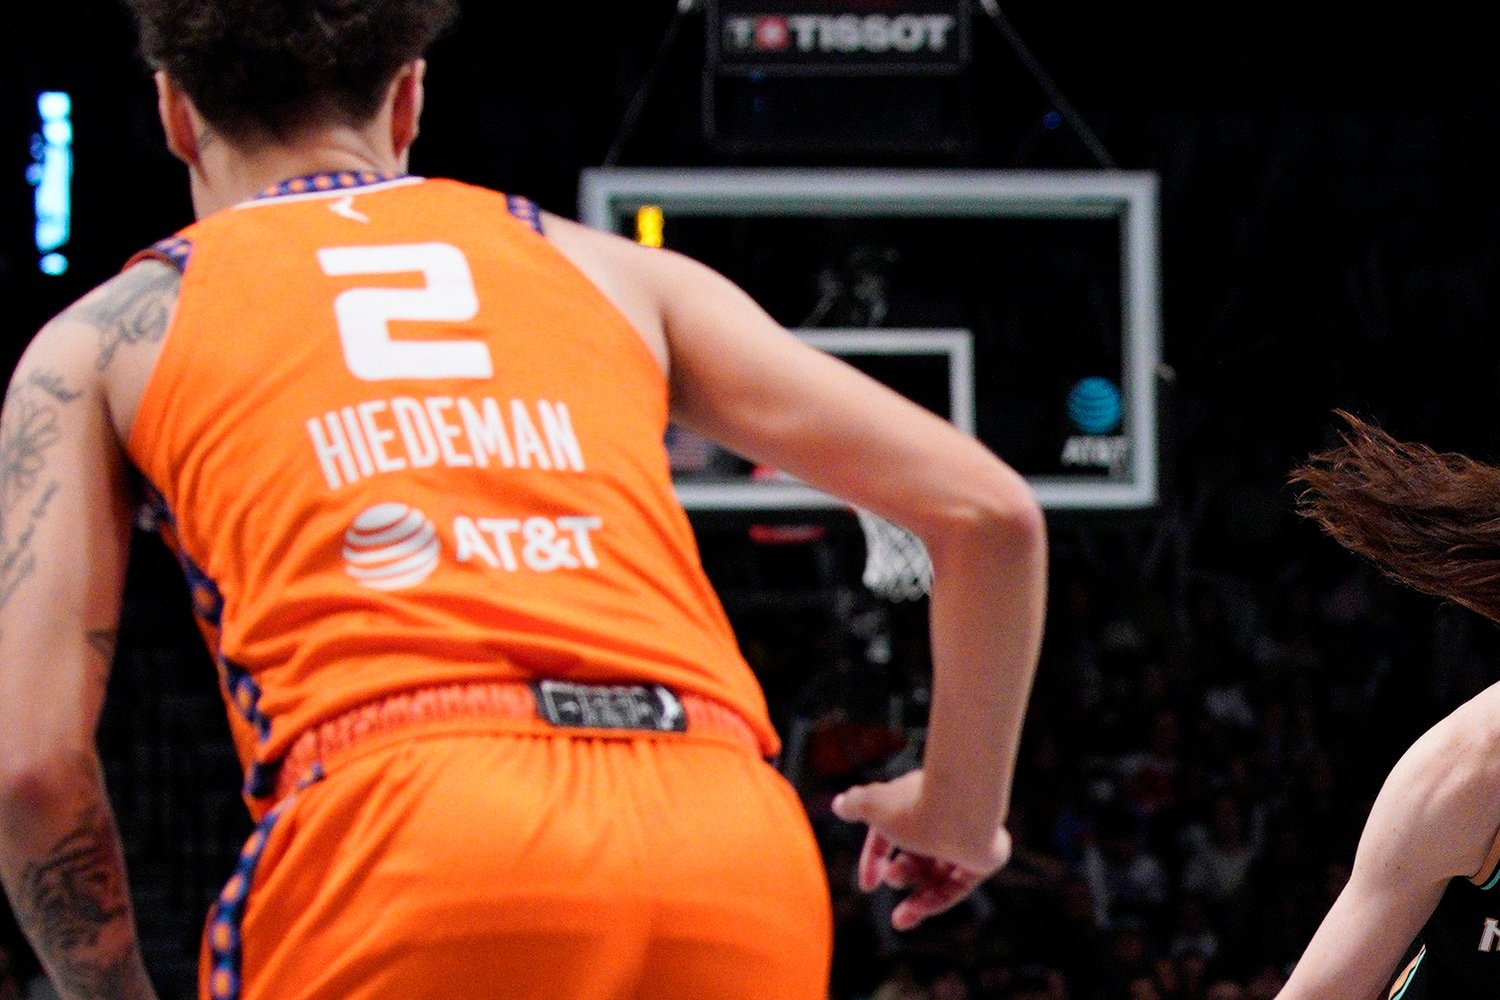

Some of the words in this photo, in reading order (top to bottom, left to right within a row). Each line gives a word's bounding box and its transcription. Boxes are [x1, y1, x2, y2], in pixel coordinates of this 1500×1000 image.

[790, 13, 956, 52] TISSOT
[316, 242, 493, 381] 2
[306, 396, 585, 491] HIEDEMAN
[452, 514, 602, 573] AT&T
